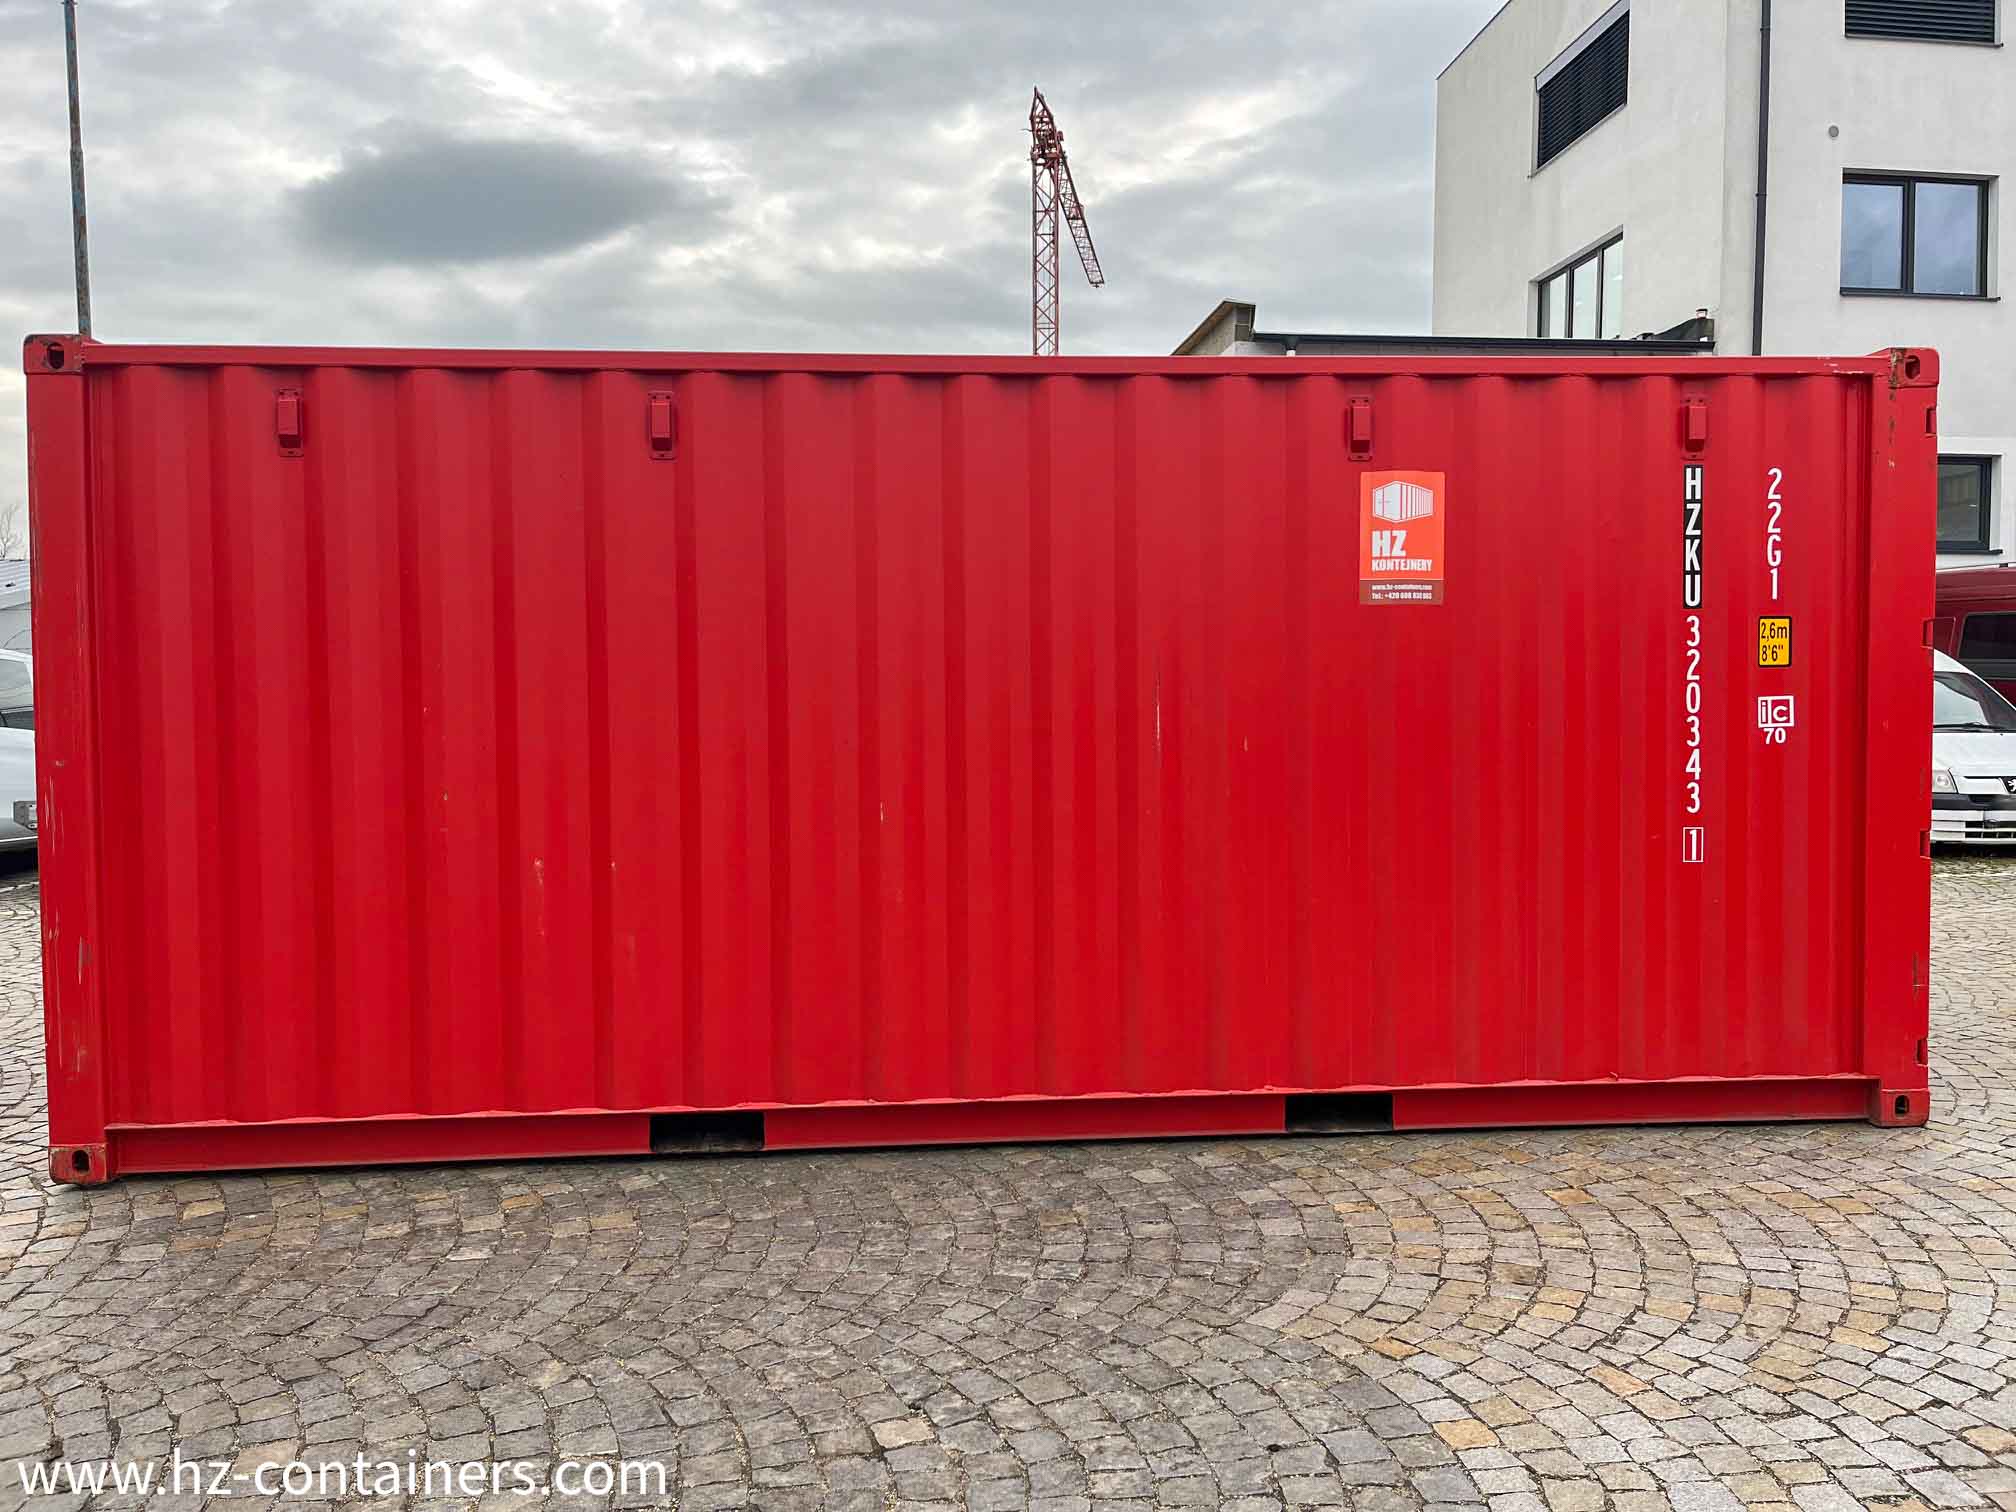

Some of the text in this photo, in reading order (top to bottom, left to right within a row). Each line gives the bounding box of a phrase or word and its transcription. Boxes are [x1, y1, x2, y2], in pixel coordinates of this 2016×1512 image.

[1372, 530, 1407, 557] HZ
[1685, 467, 1702, 607] HZKU
[1767, 467, 1782, 601] 22G1
[1371, 559, 1433, 571] KONTEJNERY
[1761, 622, 1787, 642] 2,6m
[1685, 615, 1701, 813] 320343
[1763, 728, 1786, 745] 70
